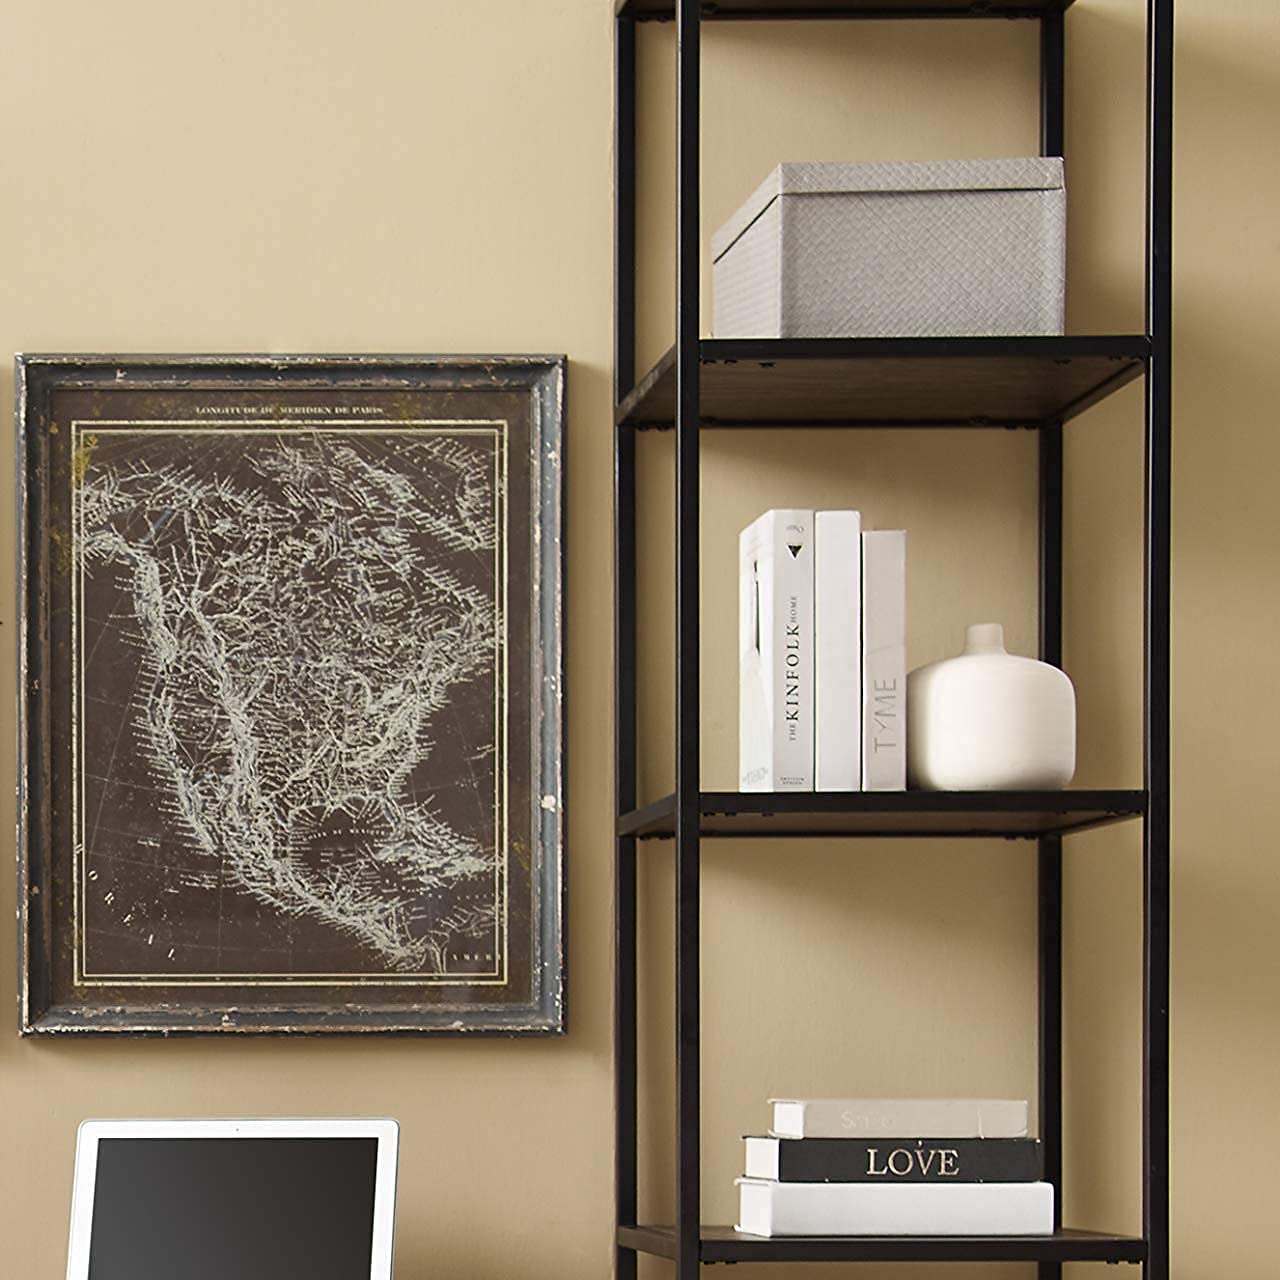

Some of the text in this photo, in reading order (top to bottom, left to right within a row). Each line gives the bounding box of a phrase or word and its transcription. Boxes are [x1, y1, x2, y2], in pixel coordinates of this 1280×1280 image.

[786, 596, 800, 741] THE KINFOLK HOME
[866, 1148, 961, 1177] LOVE
